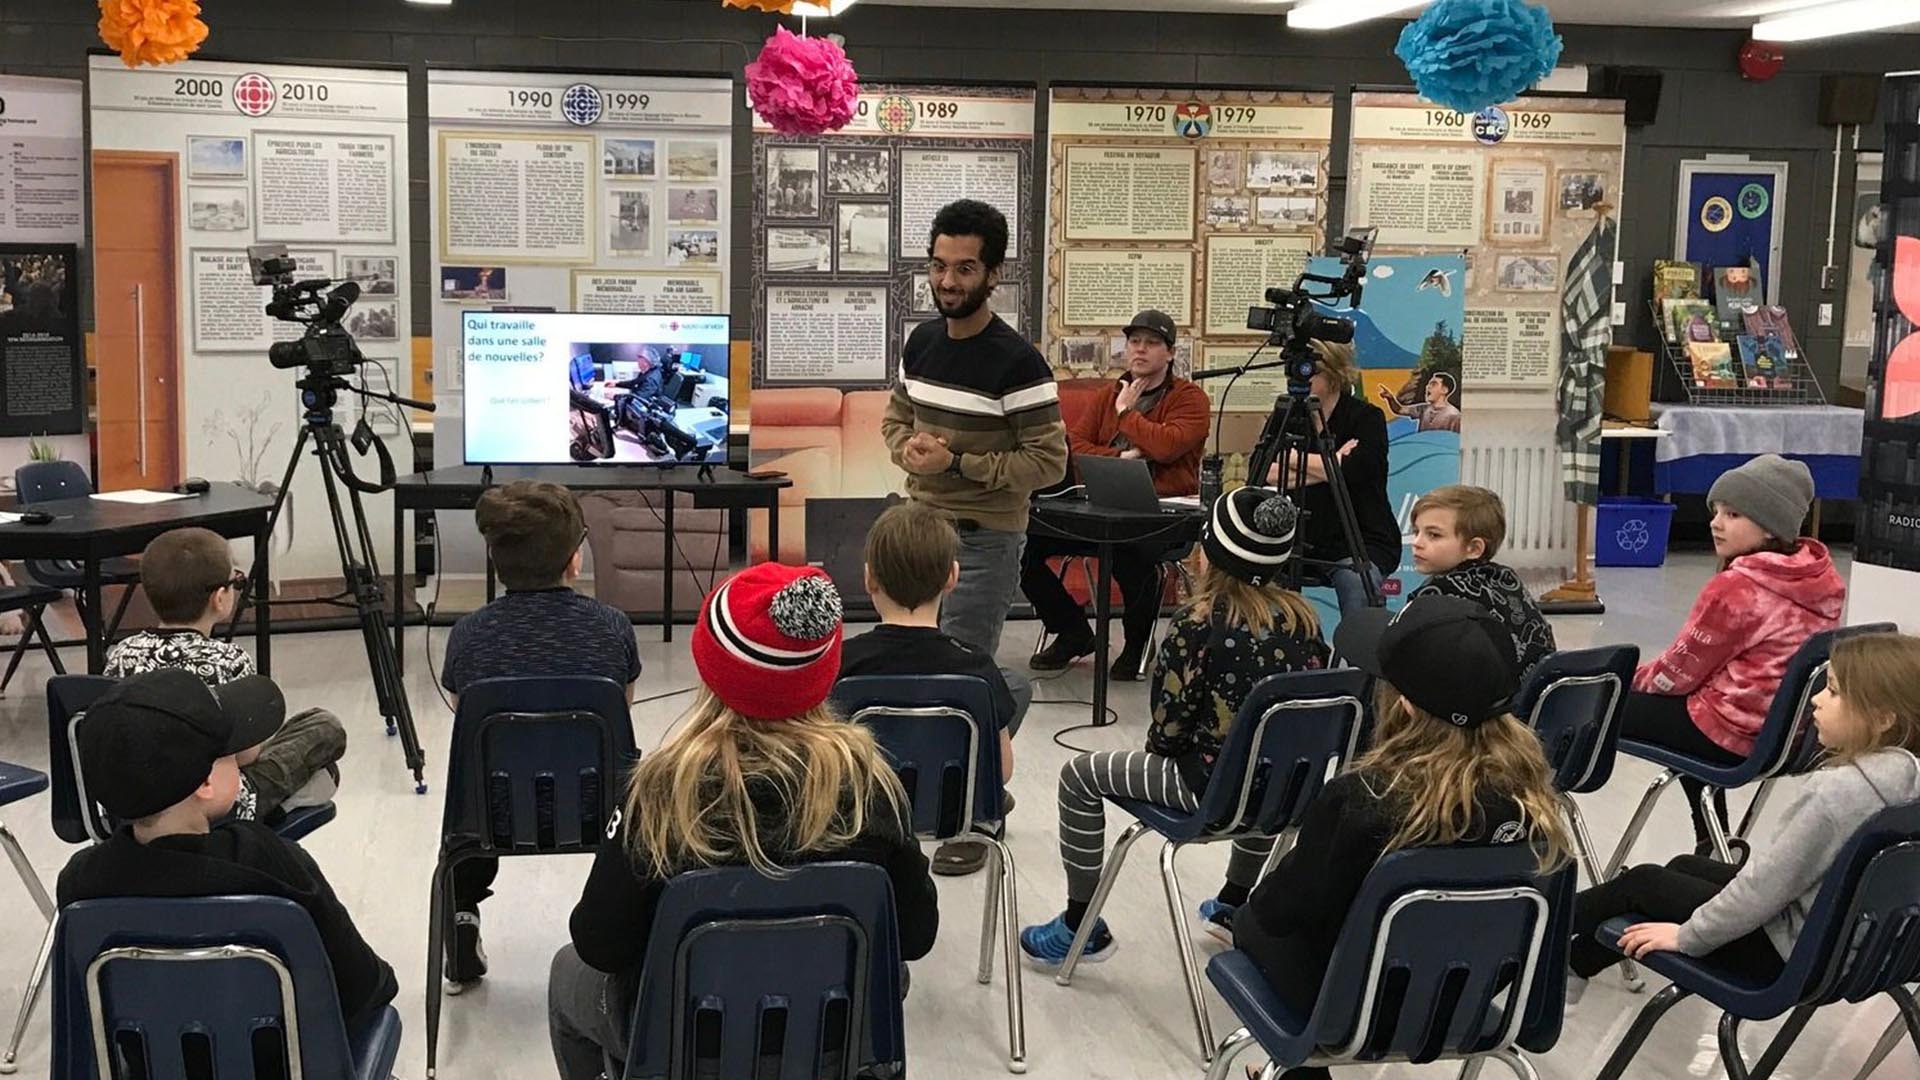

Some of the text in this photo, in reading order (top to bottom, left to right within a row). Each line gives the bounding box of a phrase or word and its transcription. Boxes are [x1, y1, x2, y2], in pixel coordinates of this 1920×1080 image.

[174, 78, 223, 97] 2000
[282, 82, 328, 101] 2010
[508, 90, 552, 108] 1990
[607, 92, 650, 110] 1999
[918, 102, 958, 118] 1989
[1124, 106, 1166, 122] 1970
[1216, 107, 1256, 122] 1979
[1426, 110, 1464, 127] 1960
[1512, 113, 1552, 129] 1969
[467, 319, 536, 330] Qui travaille
[468, 336, 494, 346] dans
[522, 336, 547, 346] salle
[468, 352, 544, 362] de nouvelles?
